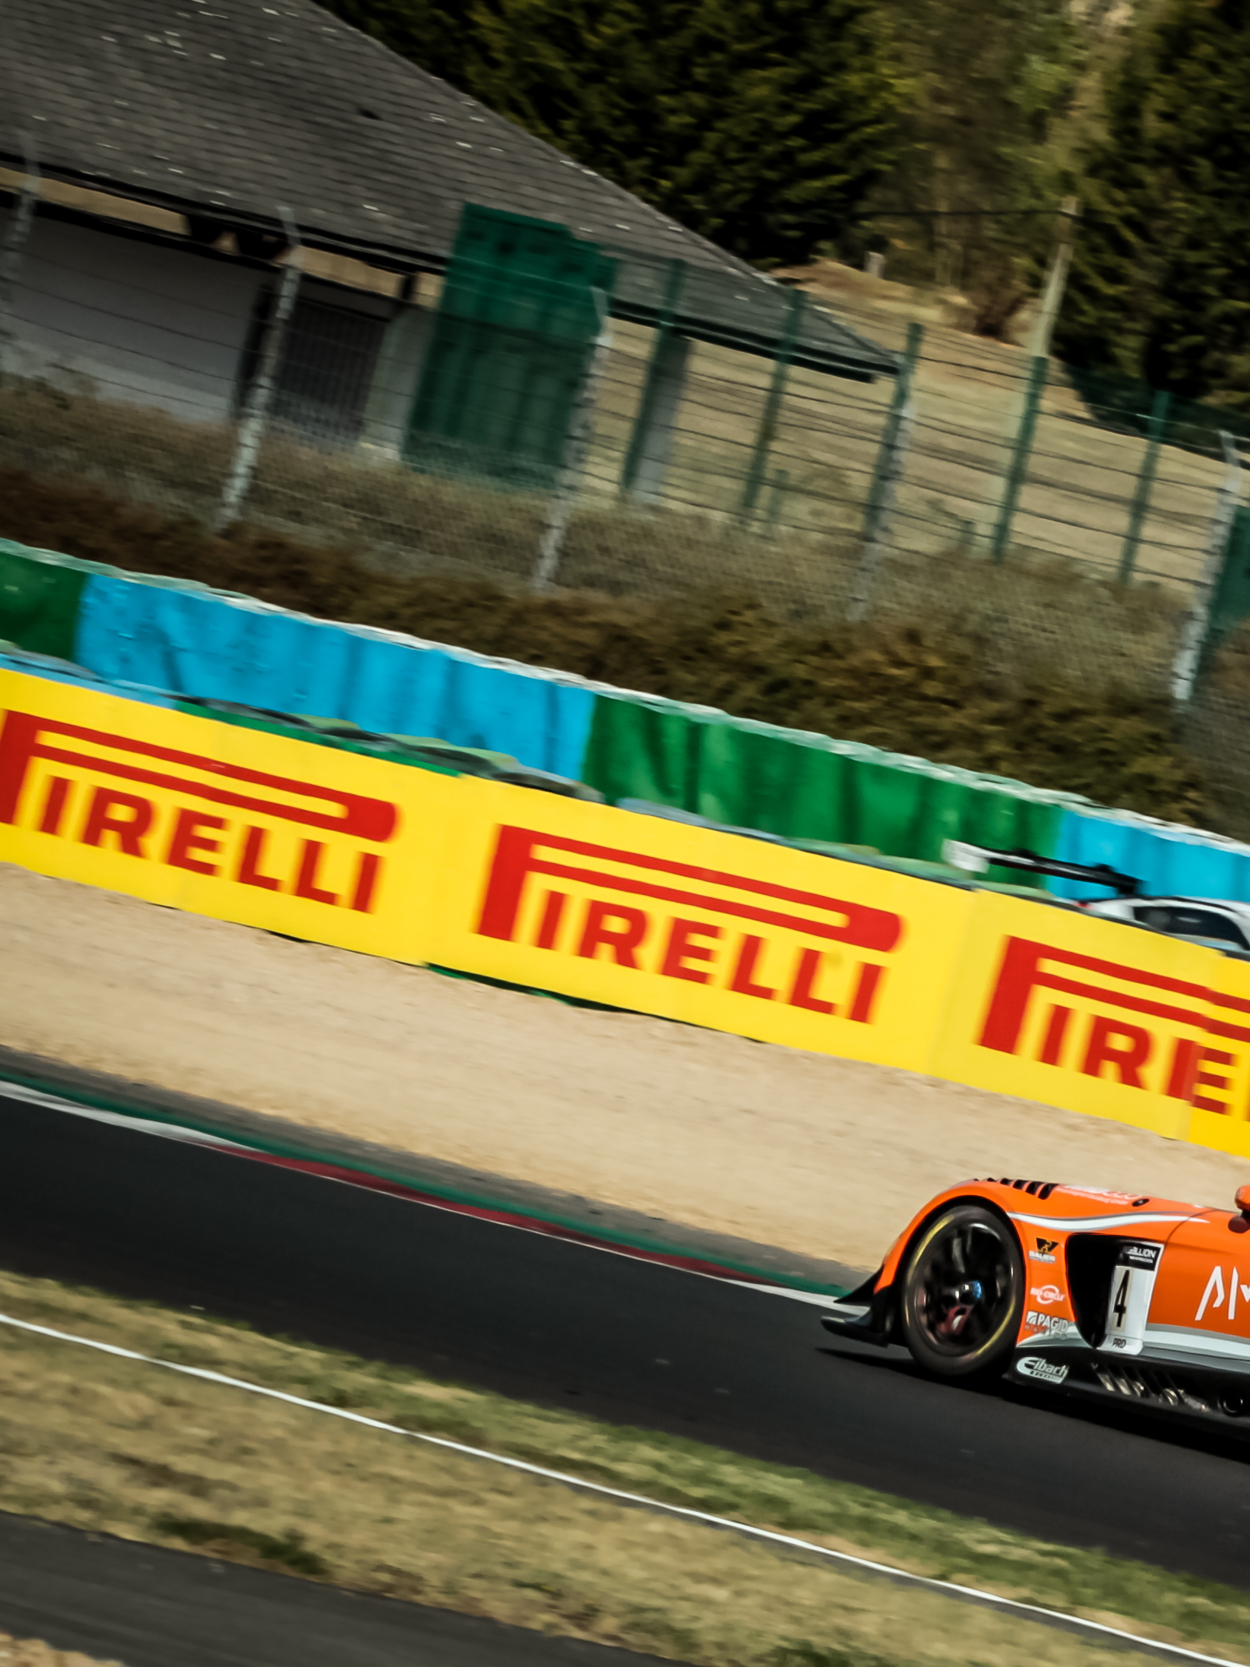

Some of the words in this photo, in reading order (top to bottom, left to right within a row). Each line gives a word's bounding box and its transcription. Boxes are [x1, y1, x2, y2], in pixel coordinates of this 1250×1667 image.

[0, 709, 402, 915] PIRELLI
[474, 822, 907, 1024] PIRELLI
[1113, 1269, 1130, 1328] 4
[1037, 1312, 1069, 1332] PAGID
[1112, 1337, 1127, 1349] PRO
[1016, 1356, 1070, 1384] Eibach
